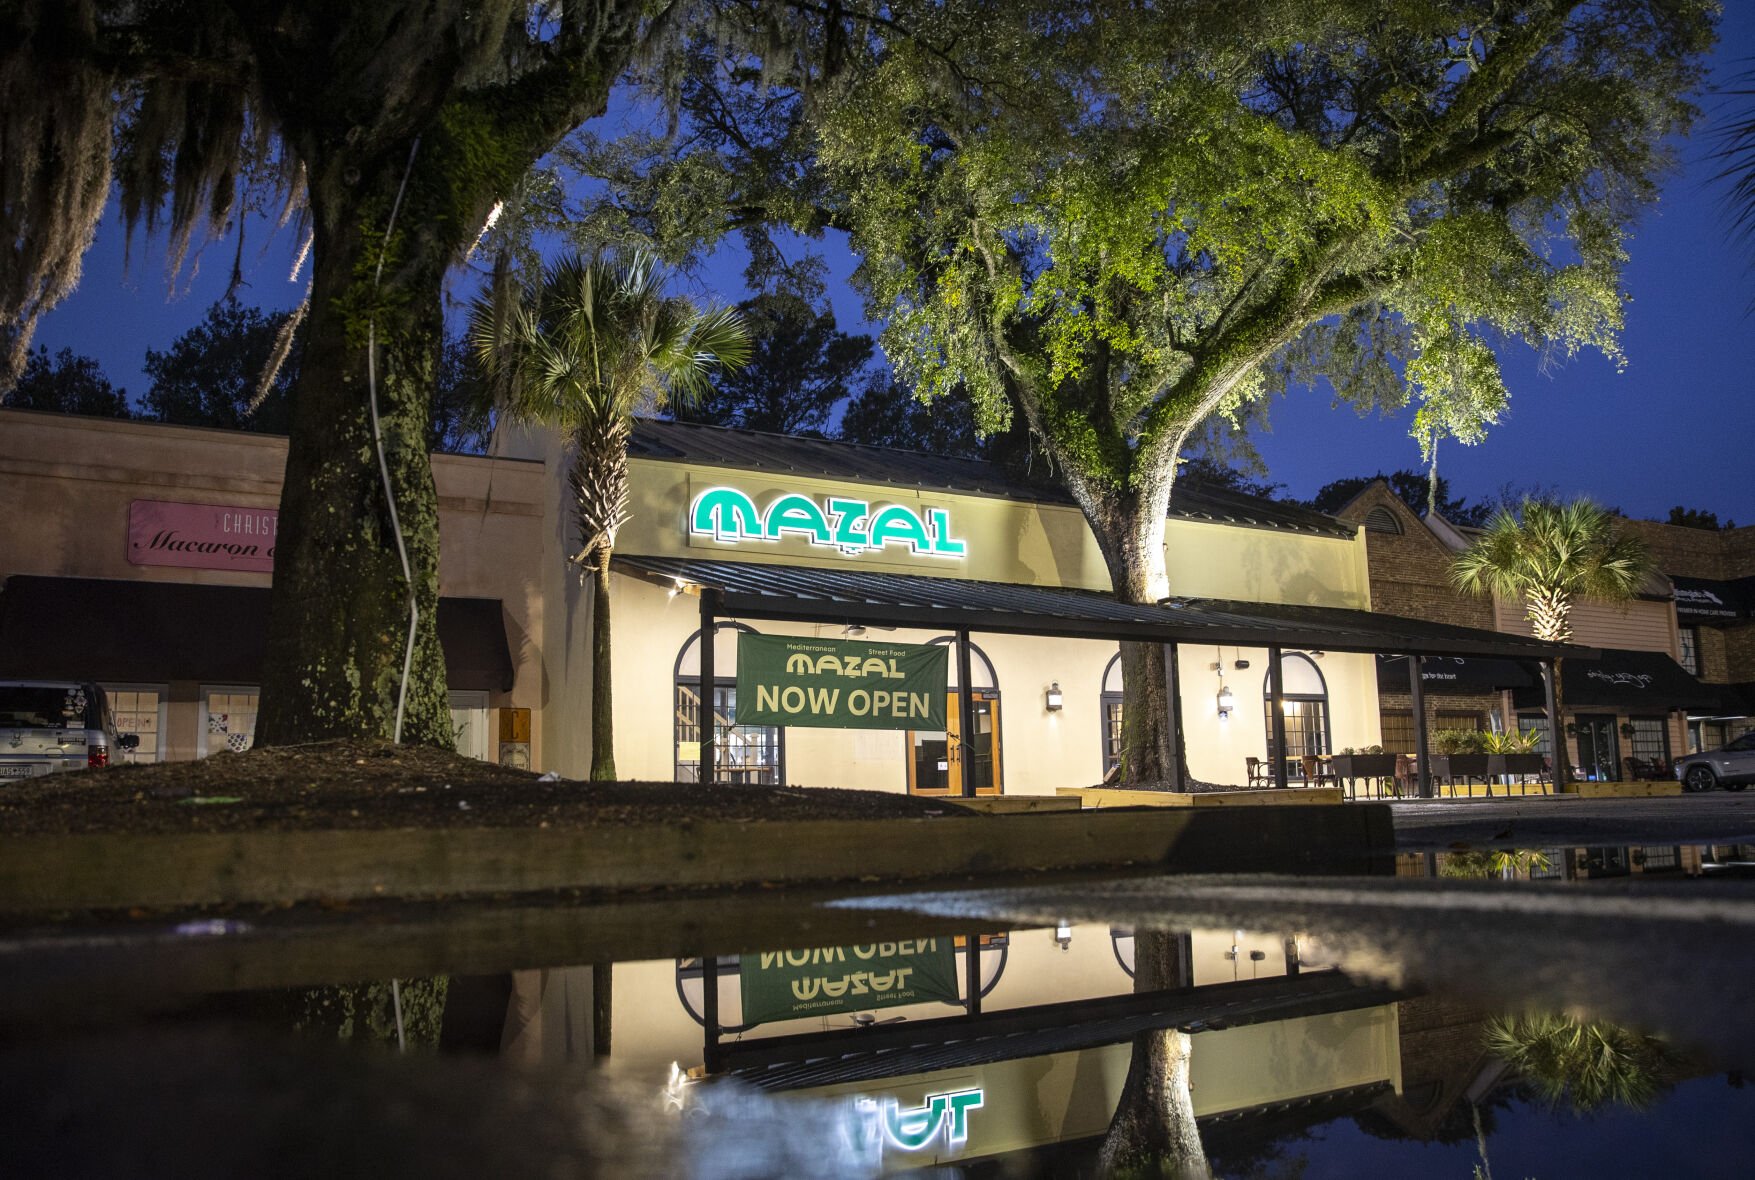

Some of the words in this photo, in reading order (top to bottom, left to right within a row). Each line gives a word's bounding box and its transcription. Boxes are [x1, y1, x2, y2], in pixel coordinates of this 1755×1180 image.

[691, 487, 967, 556] MAZAL
[134, 529, 259, 557] Macaron
[786, 643, 836, 653] Mediterranean
[868, 648, 888, 656] Street
[889, 649, 906, 657] Food
[786, 653, 905, 678] MAZAL
[756, 684, 840, 715] NOW
[847, 689, 930, 719] OPEN
[117, 717, 146, 728] OPEN
